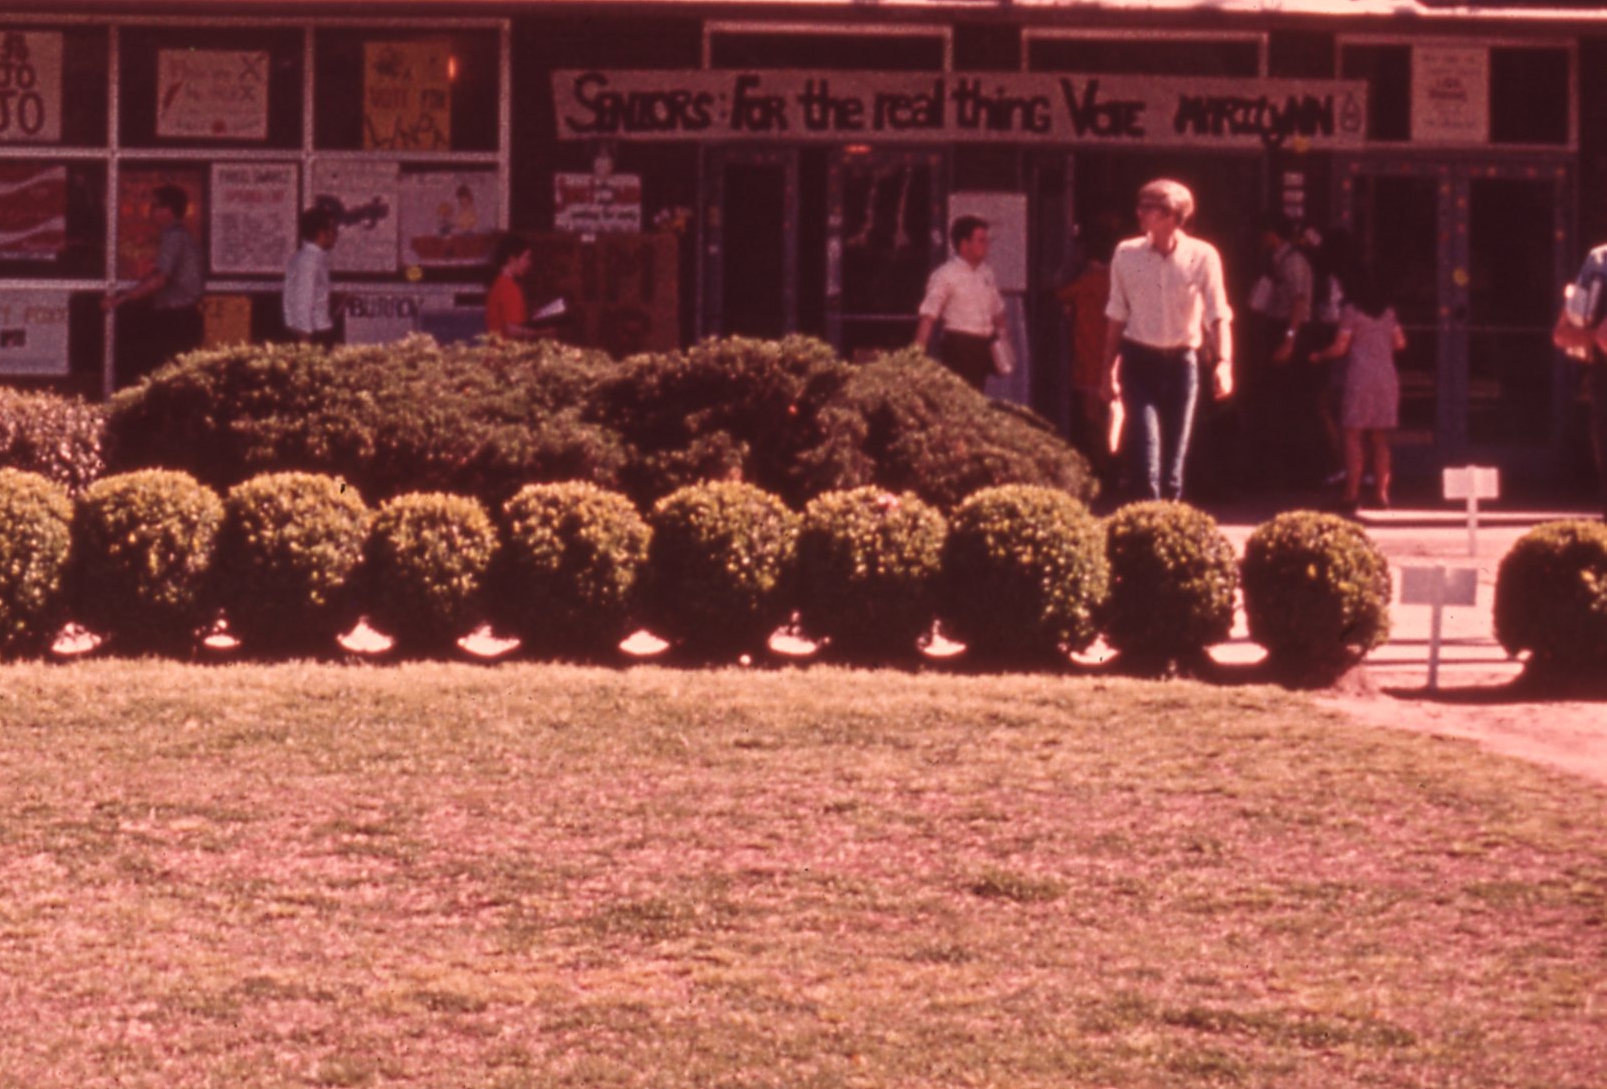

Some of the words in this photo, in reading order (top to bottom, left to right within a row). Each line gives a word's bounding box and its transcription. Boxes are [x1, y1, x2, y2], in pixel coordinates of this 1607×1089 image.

[797, 77, 864, 132] the
[873, 76, 946, 132] real
[950, 77, 1051, 135] thing
